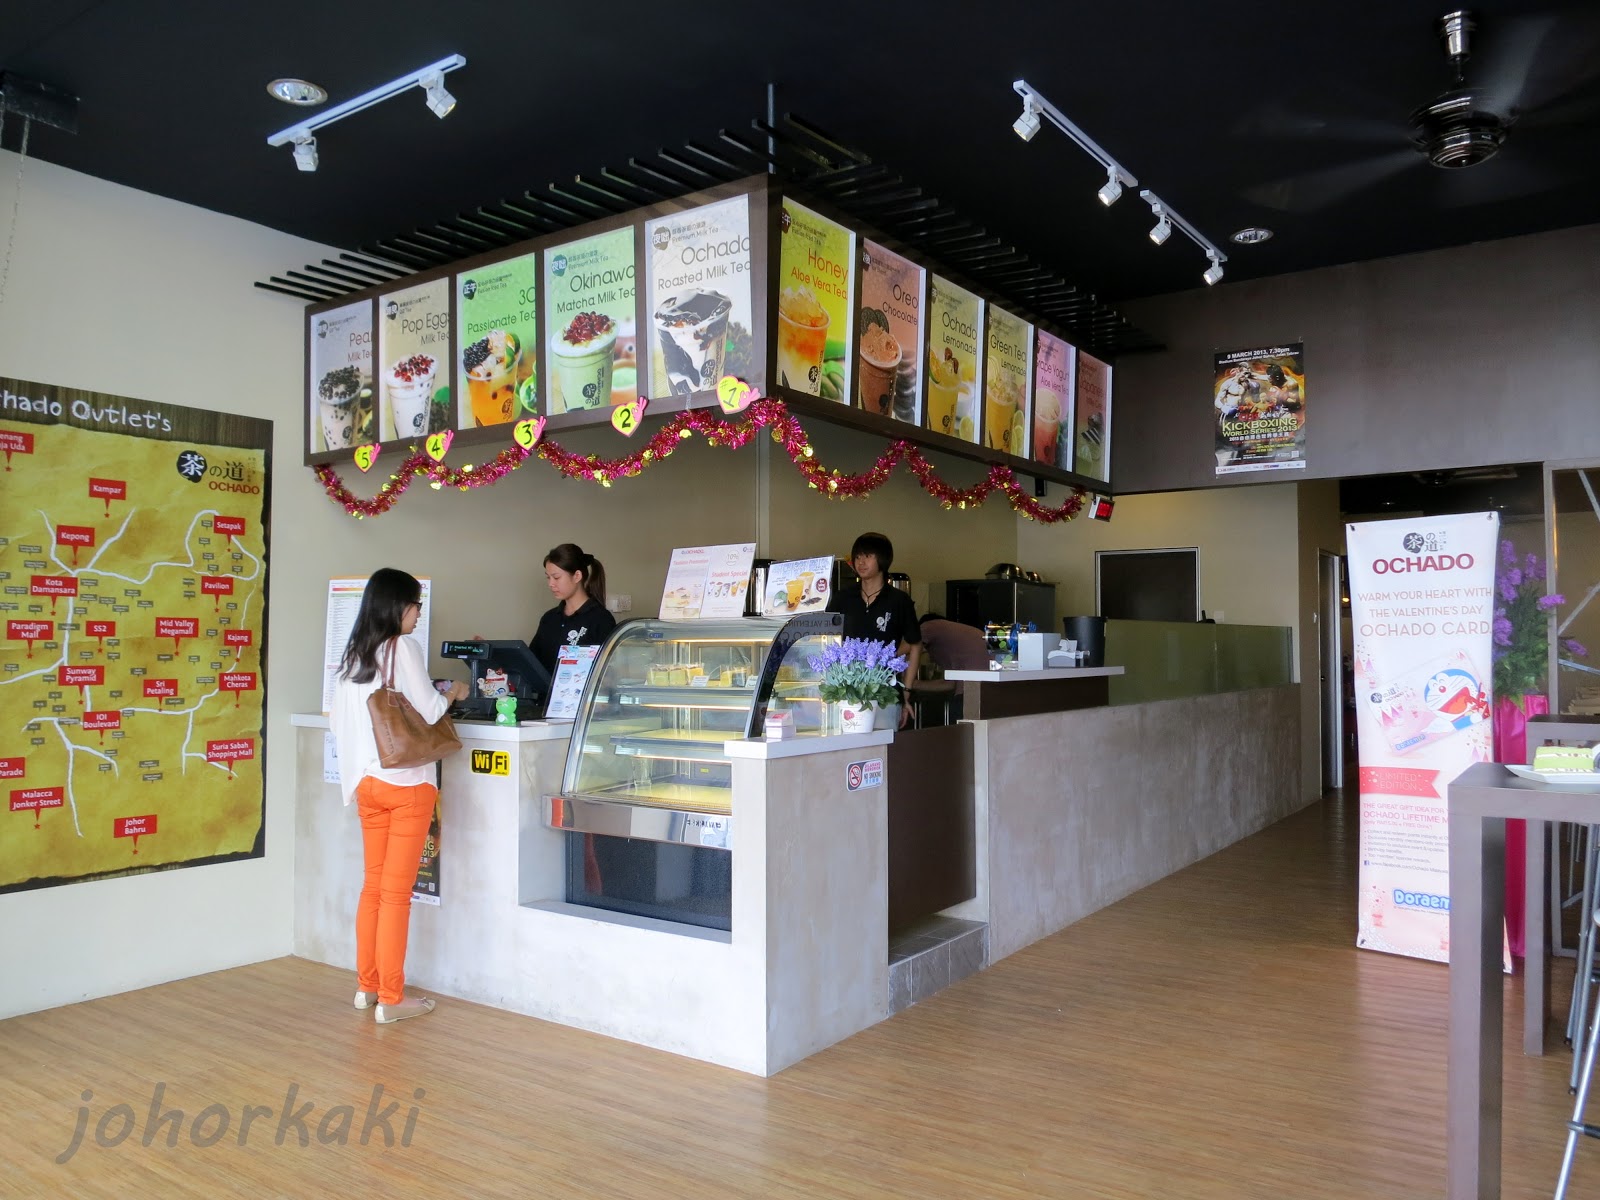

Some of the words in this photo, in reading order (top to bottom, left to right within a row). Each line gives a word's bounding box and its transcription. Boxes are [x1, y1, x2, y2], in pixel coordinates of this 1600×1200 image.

[672, 233, 695, 244] Premium
[808, 247, 849, 285] Honey
[658, 269, 703, 290] Roasted
[706, 264, 728, 279] Milk
[790, 266, 811, 284] Aloe
[812, 274, 832, 294] Vera
[833, 283, 847, 300] Tea
[556, 297, 595, 313] Matcha
[597, 290, 616, 304] Milk
[893, 284, 919, 309] Oreo
[882, 301, 918, 326] Chocolate
[402, 318, 424, 335] Pop
[467, 314, 517, 334] Passionate
[942, 311, 977, 340] Ochado
[943, 331, 976, 356] Lemonade
[990, 334, 1013, 357] Green
[1013, 344, 1026, 362] Tea
[1231, 350, 1253, 359] MARCH
[1001, 357, 1026, 376] Lemonade
[72, 400, 172, 432] Outlet's
[619, 408, 631, 428] 2
[1222, 417, 1297, 431] KICKBOXING
[521, 424, 532, 445] 3
[1250, 427, 1277, 435] SERIES
[431, 439, 440, 455] 4
[361, 452, 369, 469] 5
[93, 484, 122, 496] Kampar
[208, 481, 260, 494] OCHADO
[216, 521, 241, 531] Setapak
[61, 532, 90, 542] Kepong
[1372, 553, 1474, 574] OCHADO
[32, 586, 76, 594] Damansara
[1358, 591, 1391, 601] WARM
[1393, 590, 1423, 600] YOUR
[1425, 588, 1461, 599] HEART
[1463, 587, 1492, 597] WITH
[1369, 608, 1389, 618] THE
[1391, 605, 1458, 617] VALENTINE'S
[1461, 605, 1483, 615] DAY
[11, 623, 48, 632] Paradigm
[174, 621, 194, 629] Valley
[1360, 622, 1436, 637] OCHADO
[160, 627, 193, 636] Megamall
[227, 634, 249, 643] Kajang
[66, 668, 96, 677] Sunway
[65, 675, 97, 683] Pyramid
[146, 687, 175, 695] Petaling
[83, 720, 120, 728] Boulevard
[230, 742, 249, 750] Sabah
[207, 750, 238, 759] Shopping
[1380, 773, 1417, 782] LIMITED
[1380, 781, 1417, 791] EDITION
[22, 790, 53, 798] Malacca
[13, 801, 38, 810] Jonker
[39, 798, 61, 807] Street
[124, 818, 145, 827] Johor
[1363, 811, 1400, 819] OCHADO
[1402, 813, 1440, 823] LIFETIME
[124, 826, 146, 834] Bahru
